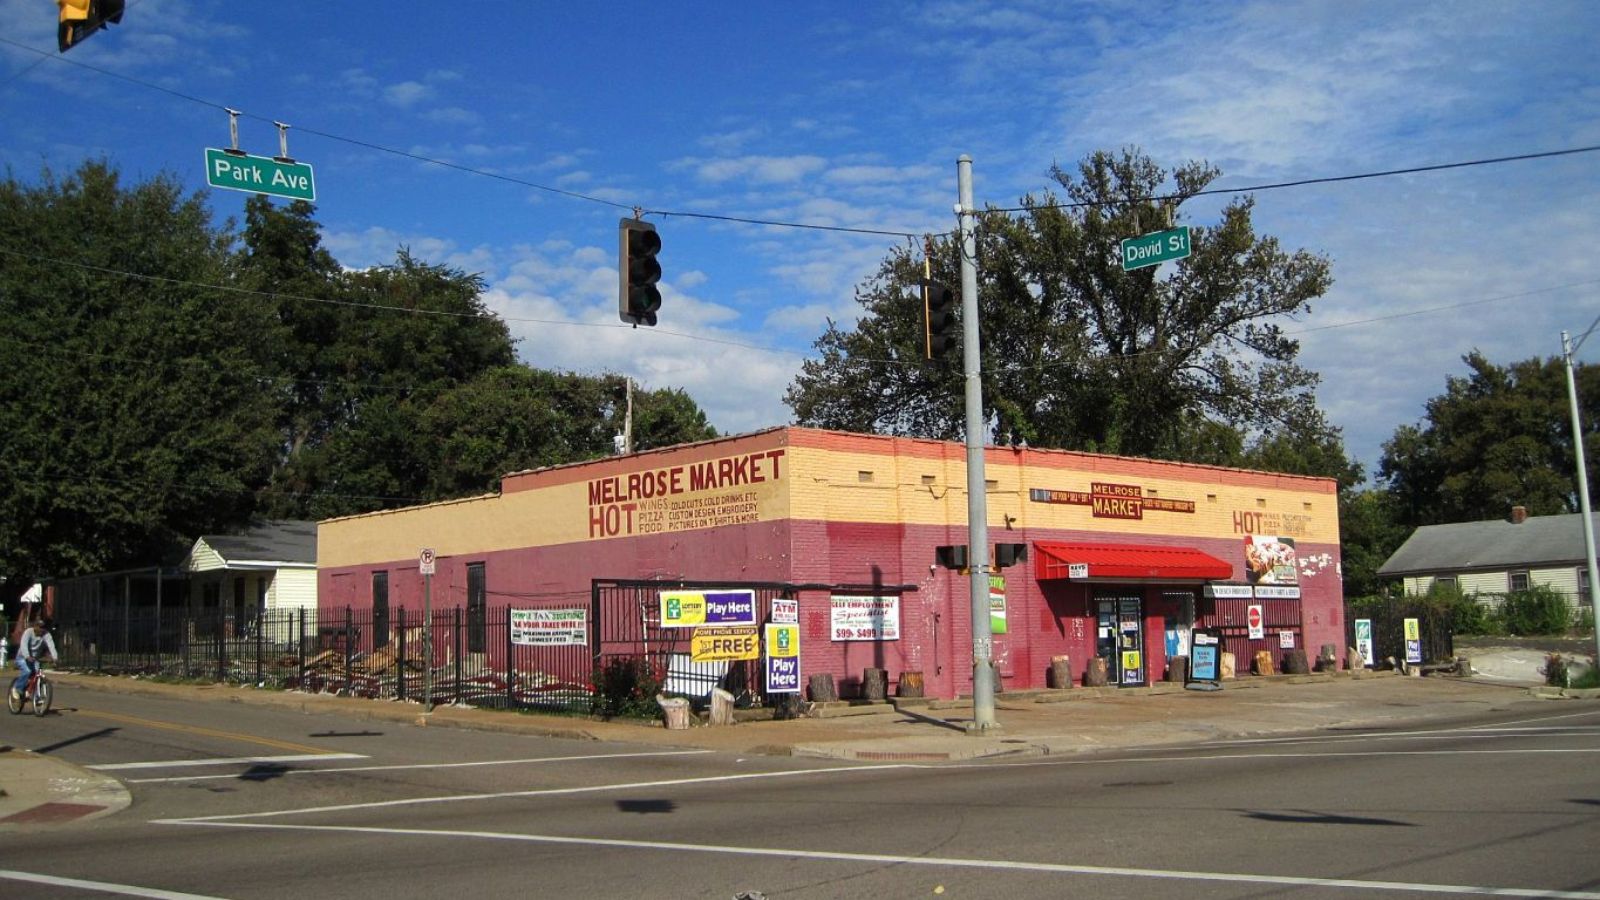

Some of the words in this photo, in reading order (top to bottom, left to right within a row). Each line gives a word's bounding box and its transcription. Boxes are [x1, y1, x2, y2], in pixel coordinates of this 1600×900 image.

[215, 159, 262, 184] Park
[271, 168, 308, 190] Ave
[1127, 239, 1162, 262] David
[1169, 234, 1185, 251] St
[588, 467, 684, 506] MELROSE
[690, 450, 785, 492] MARKET
[1093, 484, 1140, 496] MELROSE
[640, 498, 668, 511] WINGS
[1093, 498, 1142, 516] MARKET
[640, 511, 664, 523] PIZZA
[668, 510, 694, 520] CUSTOM
[694, 507, 716, 518] DESIGN
[589, 503, 637, 538] HOT
[668, 520, 698, 530] PICTURES
[700, 518, 708, 527] ON
[1233, 510, 1262, 534] HOT
[640, 522, 662, 533] FOOD
[707, 602, 727, 615] Play
[728, 602, 750, 613] Here
[775, 605, 796, 613] ATM
[833, 609, 888, 620] Specialist
[713, 638, 753, 654] FREE
[773, 658, 795, 674] Play
[770, 672, 796, 686] Here
